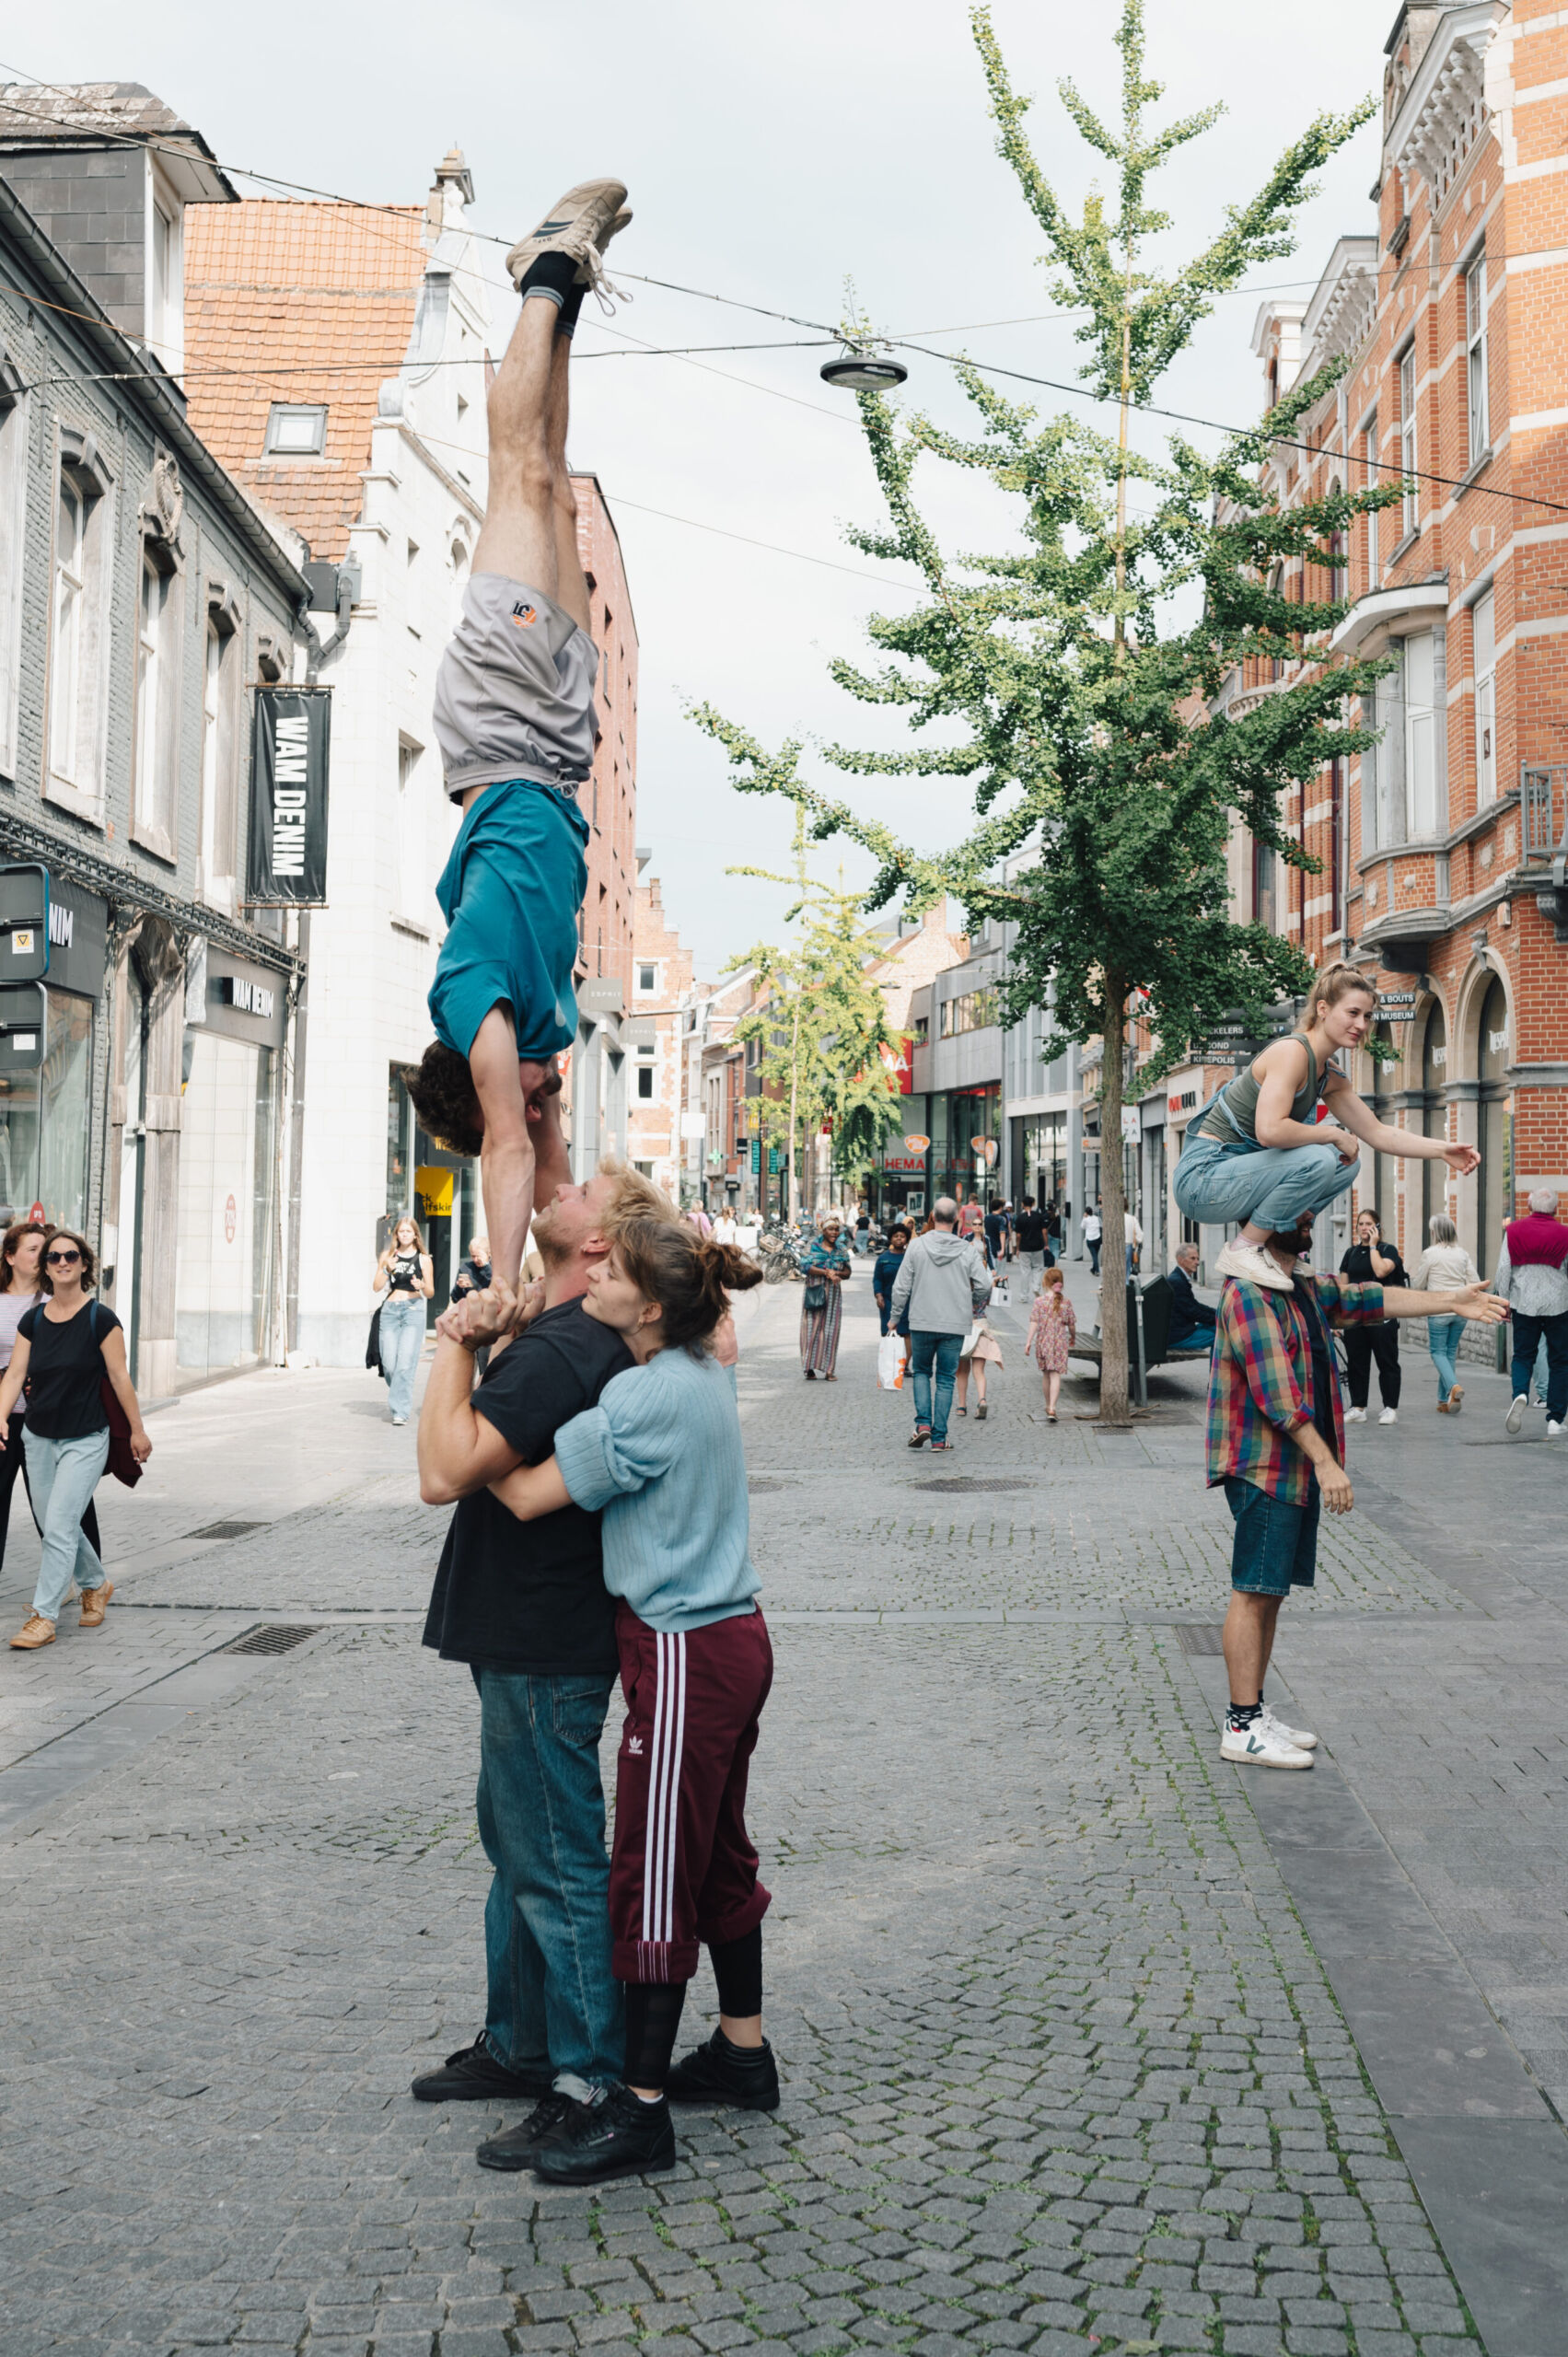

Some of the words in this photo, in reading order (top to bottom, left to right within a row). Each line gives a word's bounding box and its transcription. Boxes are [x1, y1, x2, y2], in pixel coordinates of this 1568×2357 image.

[274, 716, 308, 783] WAM
[272, 789, 307, 876] DENIM
[49, 902, 74, 948] NIM
[233, 976, 251, 1011] WAM
[252, 984, 273, 1018] DENIM
[1380, 995, 1386, 1004] &
[1387, 994, 1414, 1004] BOUTS
[1381, 1012, 1414, 1021] MUSEUM
[1211, 1026, 1244, 1035] KELERS
[1193, 1055, 1236, 1064] KIEPOLIS
[885, 1157, 925, 1170] HEMA
[425, 1202, 452, 1212] lfski
